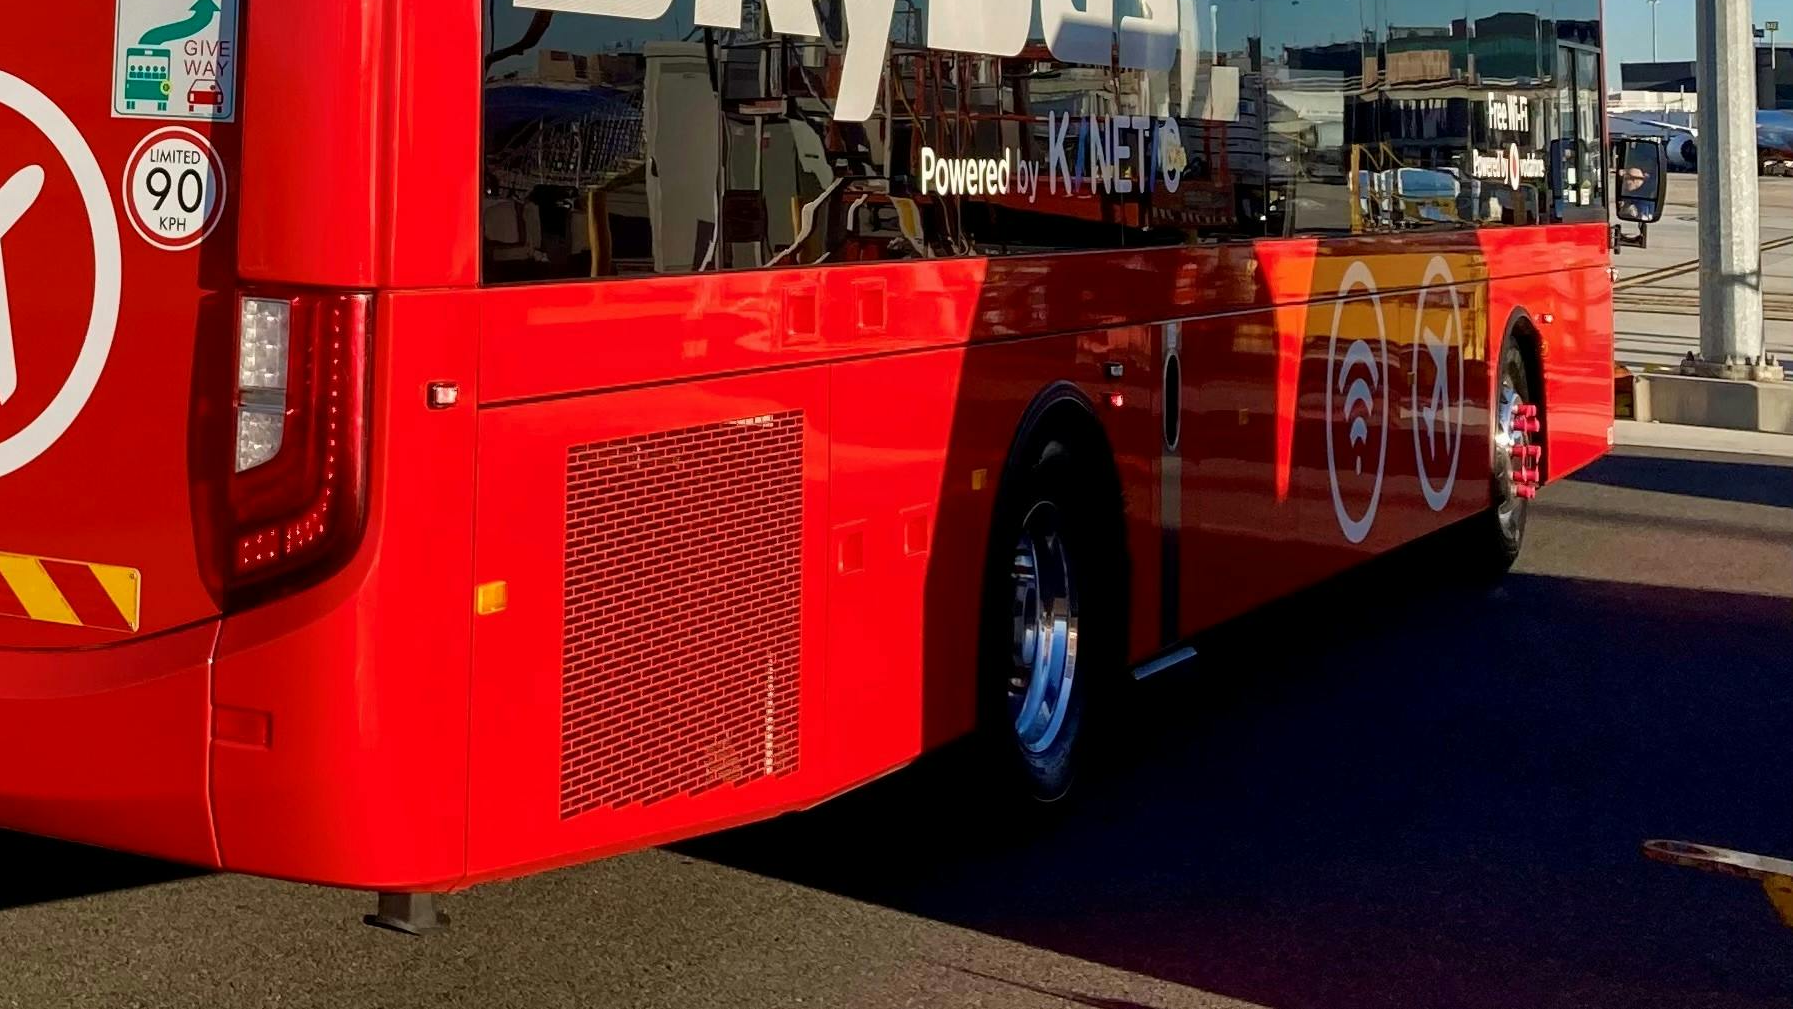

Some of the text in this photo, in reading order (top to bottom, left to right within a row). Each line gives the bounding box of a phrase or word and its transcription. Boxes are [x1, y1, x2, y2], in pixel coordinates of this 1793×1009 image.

[183, 40, 231, 58] GIVE
[183, 59, 230, 77] WAY
[1487, 91, 1507, 131] Free
[150, 148, 201, 165] LIMITED
[920, 146, 1011, 196] Powered
[1016, 147, 1039, 204] by
[145, 167, 203, 214] 90
[159, 216, 186, 232] KPH
